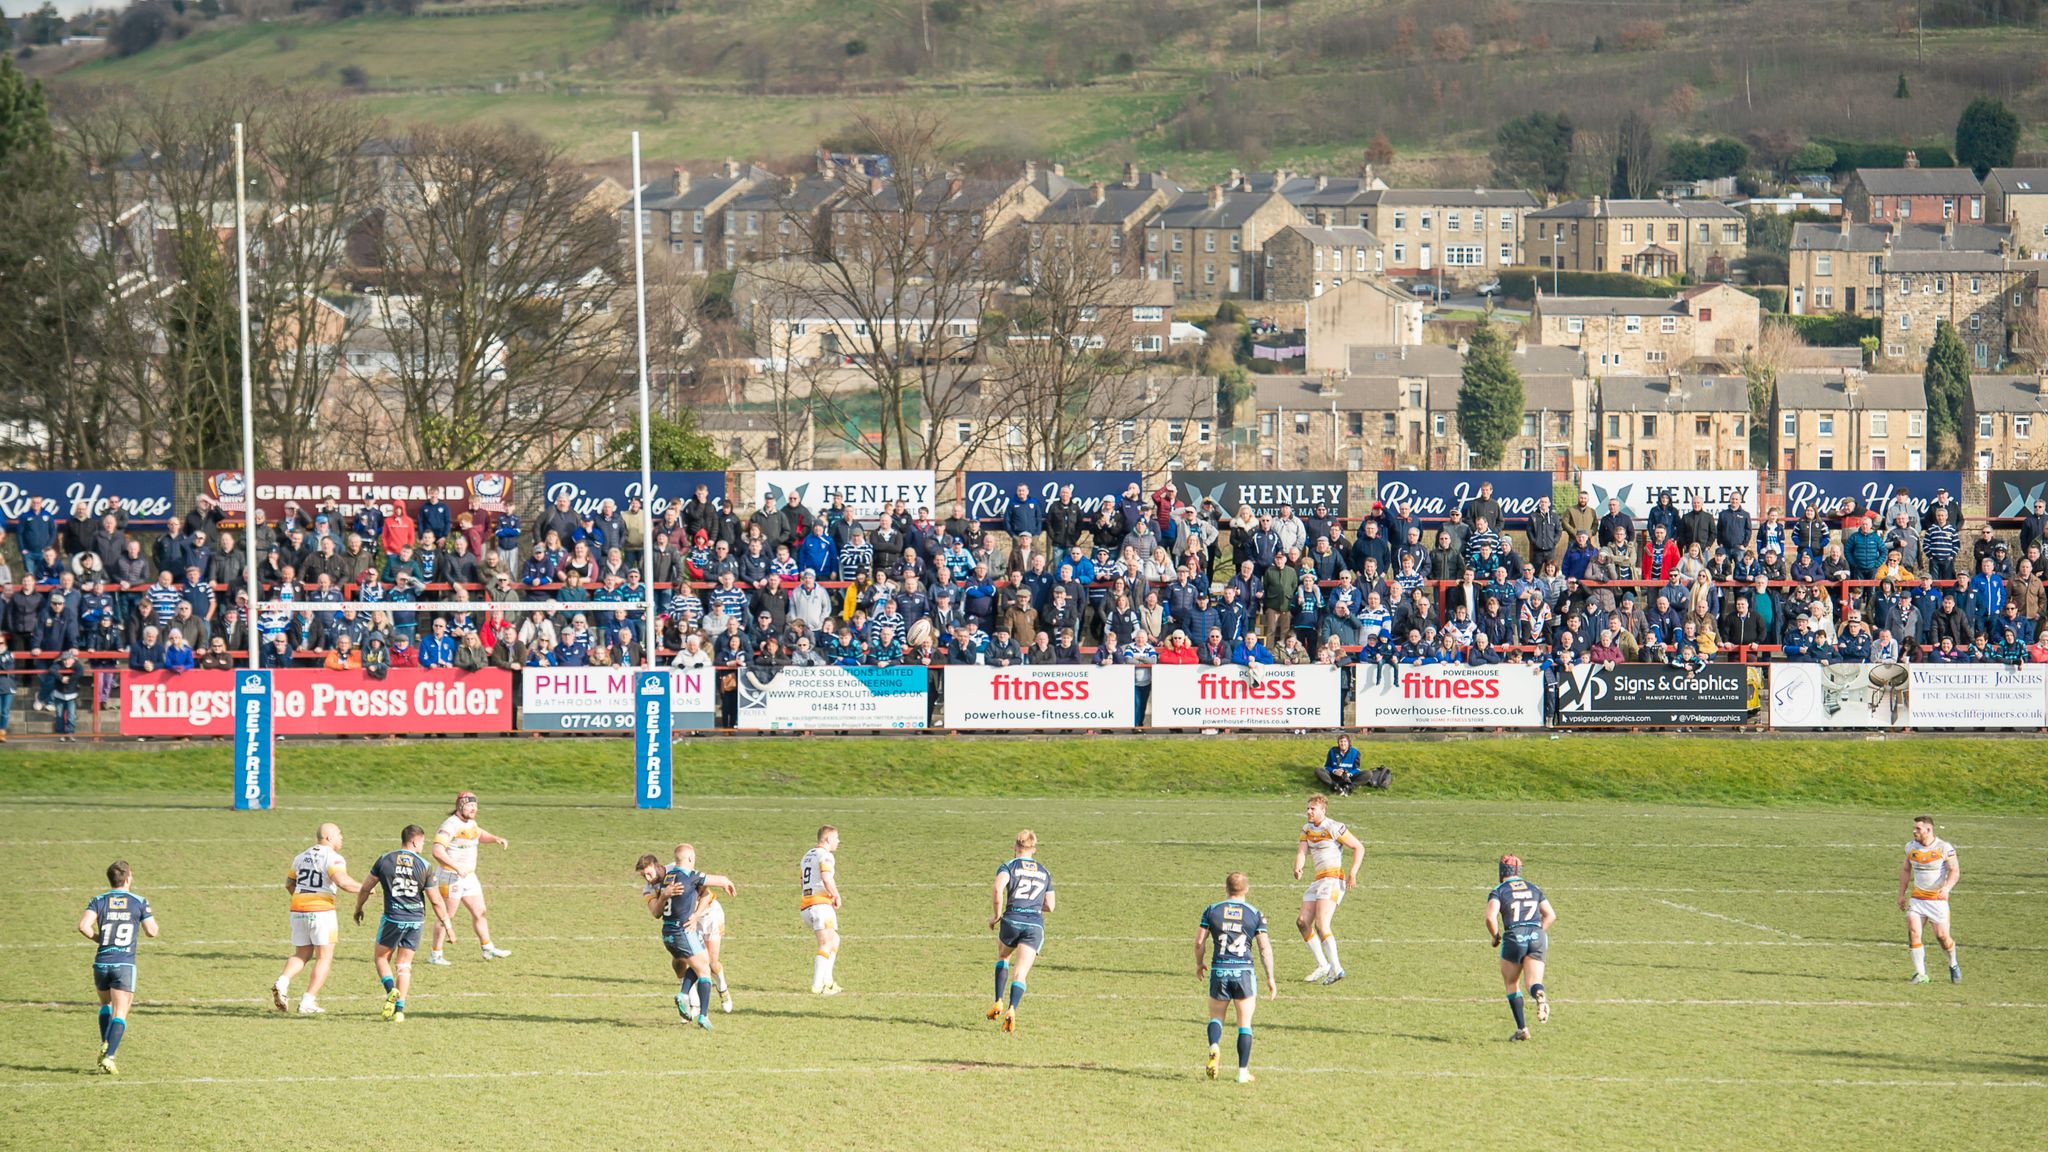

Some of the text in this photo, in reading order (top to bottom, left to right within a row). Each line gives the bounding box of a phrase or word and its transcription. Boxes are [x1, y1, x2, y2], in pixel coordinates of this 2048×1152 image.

[347, 472, 374, 482] THE
[256, 485, 341, 500] CRAIG
[823, 485, 928, 504] HENLEY
[968, 481, 1010, 517] Ri
[1238, 484, 1344, 505] HENLEY
[1381, 481, 1541, 515] Riva Hme
[1645, 486, 1750, 504] HENLEY
[1251, 508, 1281, 517] RANIT
[1298, 508, 1339, 517] MALE
[784, 669, 914, 677] ROJEX SOLUTIONS LIMITED
[1238, 670, 1296, 678] POHOUSE
[1442, 669, 1499, 677] POWERHOUSE
[1912, 671, 2043, 687] WESTCLIFFE JOINERS
[535, 675, 701, 694] PHIL MIN
[789, 679, 903, 688] PROCESS ENGINEERING
[990, 674, 1090, 701] fitness
[1197, 673, 1296, 700] fitness
[1401, 672, 1500, 699] fitness
[1614, 674, 1739, 694] Signs & Graphics
[769, 689, 923, 699] WWW.PROJEXSOLUTIONS.CO.UK
[1945, 692, 1981, 700] ENGLISH
[129, 681, 504, 726] Kingsne Press Cider
[535, 698, 602, 707] BATHROOM
[811, 703, 877, 711] 01484 711 333
[964, 709, 1114, 721] powerhouse-fitness.co.uk
[1172, 707, 1321, 716] YOUR HOME FITNESS STORE
[1375, 705, 1524, 717] powerhouse-fitness.co.uk
[1568, 714, 1651, 723] vpsignsandgraphics.com
[1678, 714, 1741, 723] @VPsignsgraphics
[1912, 708, 2043, 721] www.westcliffejoiners.co.uk
[561, 714, 612, 729] 07740
[245, 699, 261, 800] BETFRED
[646, 701, 662, 799] BETFRED
[298, 868, 323, 888] 20
[1014, 879, 1046, 900] 27
[1510, 900, 1539, 922] 17
[101, 923, 135, 946] 19
[1218, 933, 1248, 957] 14
